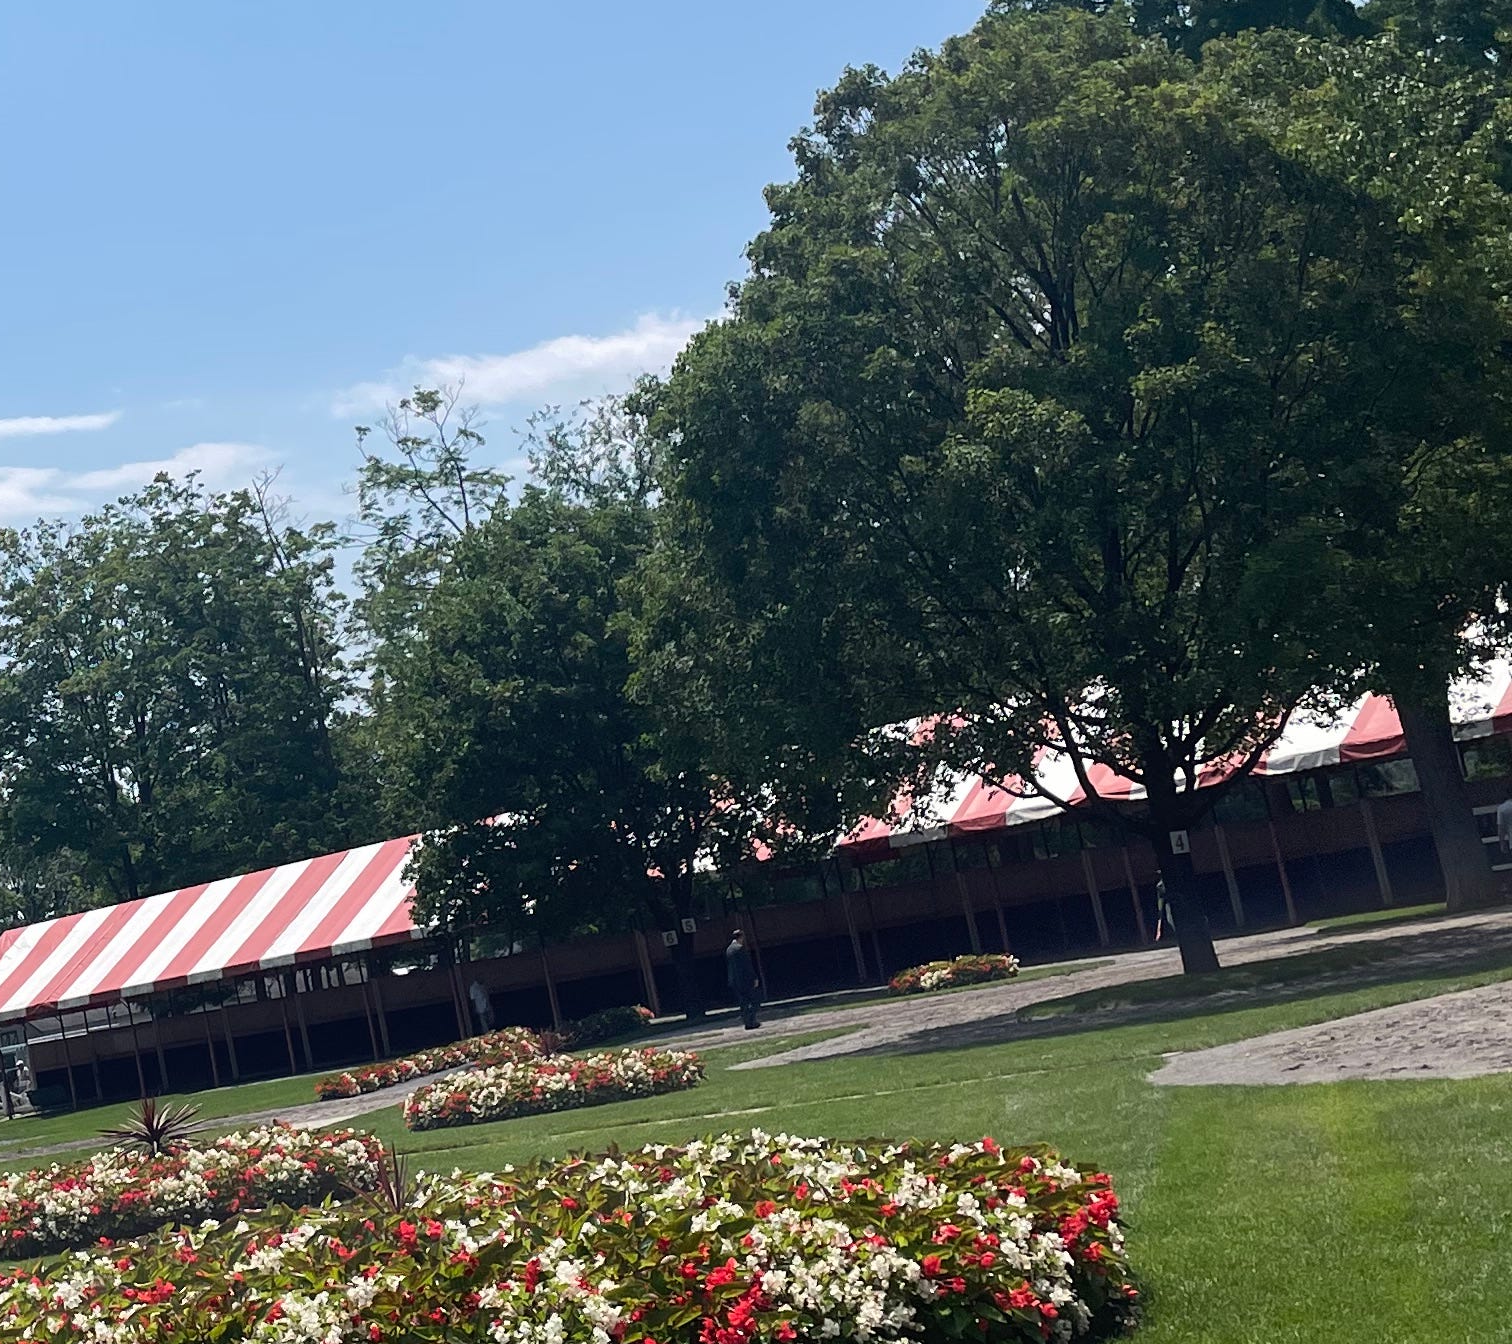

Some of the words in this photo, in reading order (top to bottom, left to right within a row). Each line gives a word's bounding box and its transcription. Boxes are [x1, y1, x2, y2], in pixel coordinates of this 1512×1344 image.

[1176, 834, 1185, 851] 4
[685, 920, 694, 931] 5
[666, 932, 674, 944] 6
